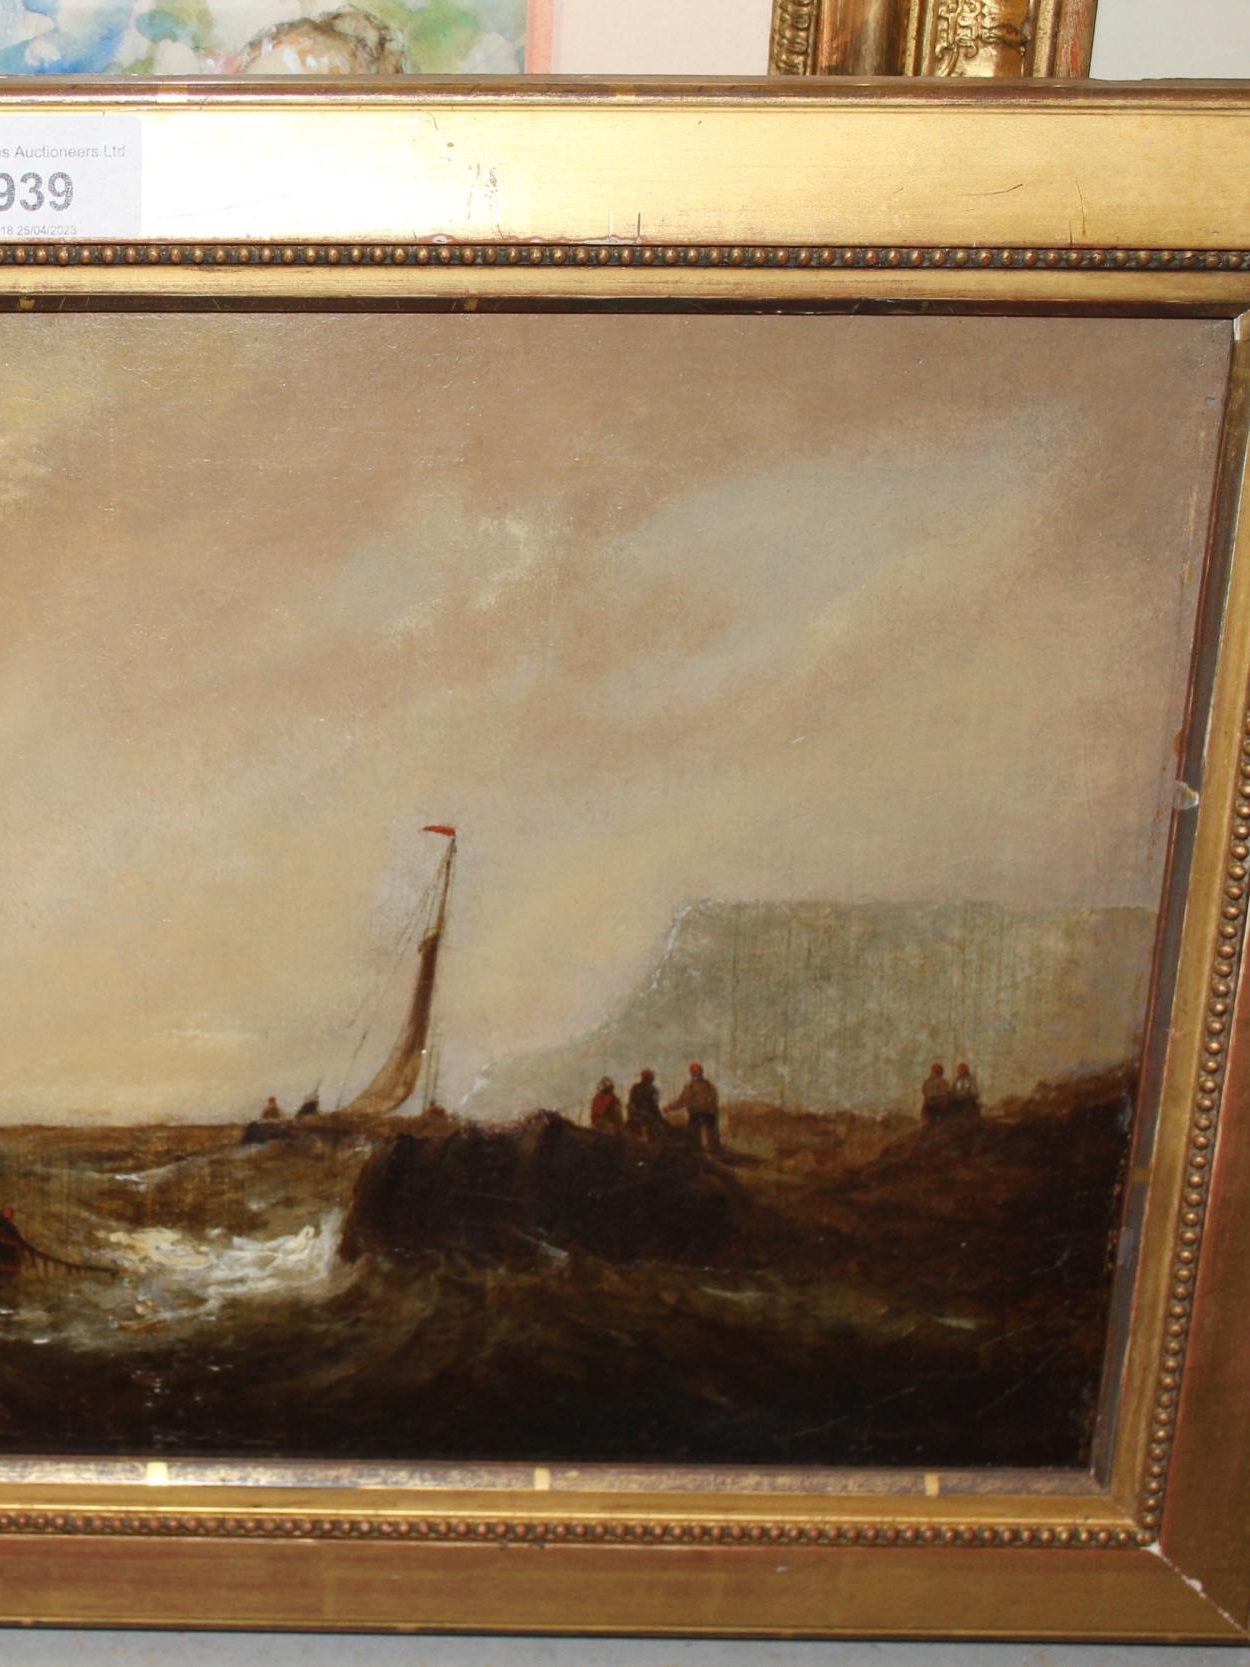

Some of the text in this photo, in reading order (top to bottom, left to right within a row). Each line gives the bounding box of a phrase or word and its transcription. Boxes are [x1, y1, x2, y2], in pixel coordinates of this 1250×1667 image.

[15, 145, 99, 158] Auctioneers
[103, 145, 126, 158] Ltd
[16, 225, 77, 236] 25/04/2023
